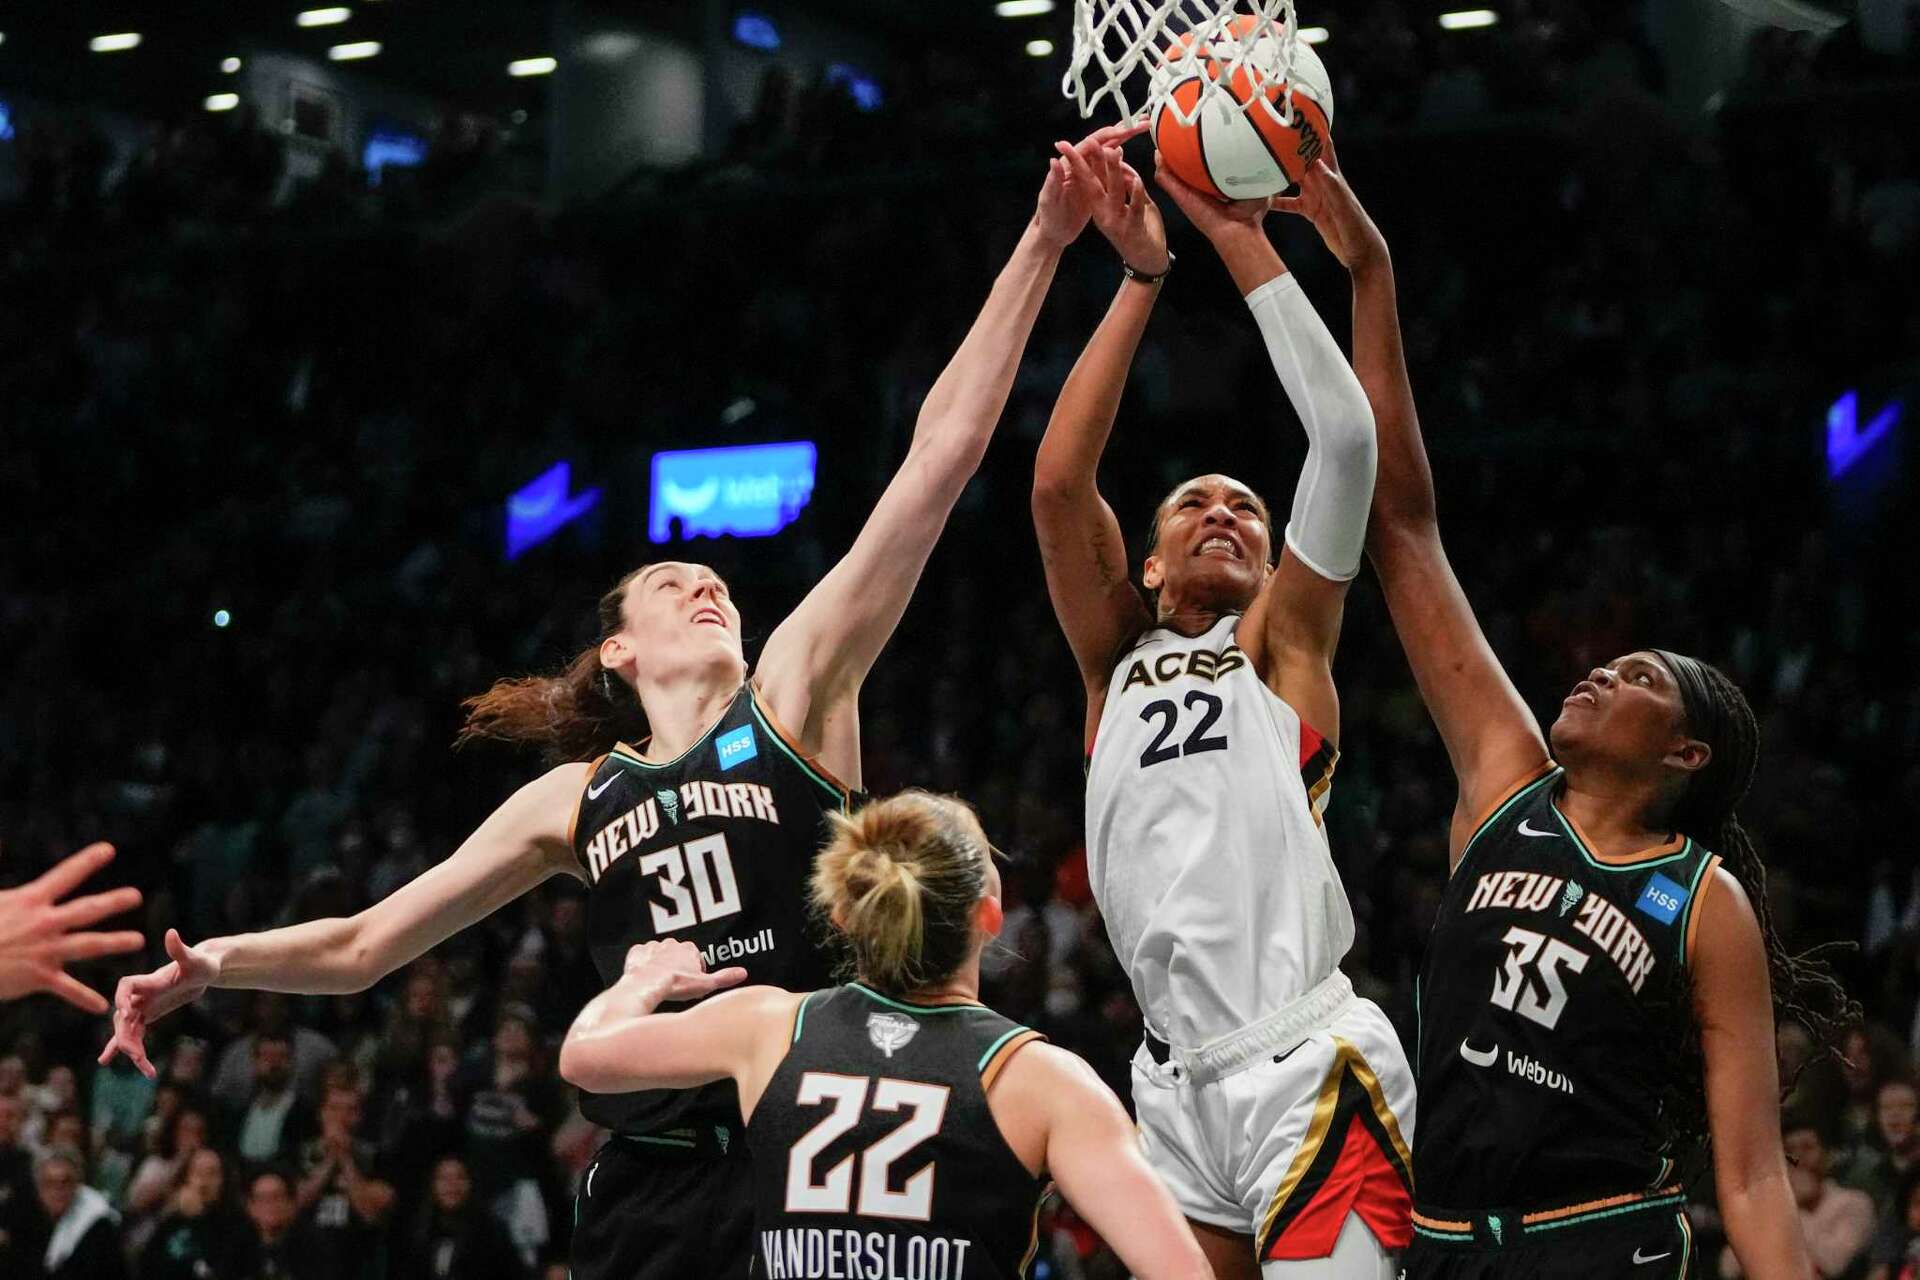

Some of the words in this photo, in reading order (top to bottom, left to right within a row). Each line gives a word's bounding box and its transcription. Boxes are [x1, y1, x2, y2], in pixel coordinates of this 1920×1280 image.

[1121, 645, 1245, 695] ACES
[721, 738, 751, 759] HSS
[1139, 690, 1228, 768] 22
[586, 797, 660, 885] NEW
[680, 780, 780, 825] YORK
[639, 832, 742, 935] 30
[1646, 886, 1678, 912] HSS
[1464, 871, 1564, 914] NEW
[1572, 891, 1656, 996] YORK
[1490, 926, 1590, 1031] 35
[1507, 1051, 1574, 1094] Webull
[784, 1071, 950, 1221] 22
[761, 1228, 971, 1280] VANDERSLOOT
